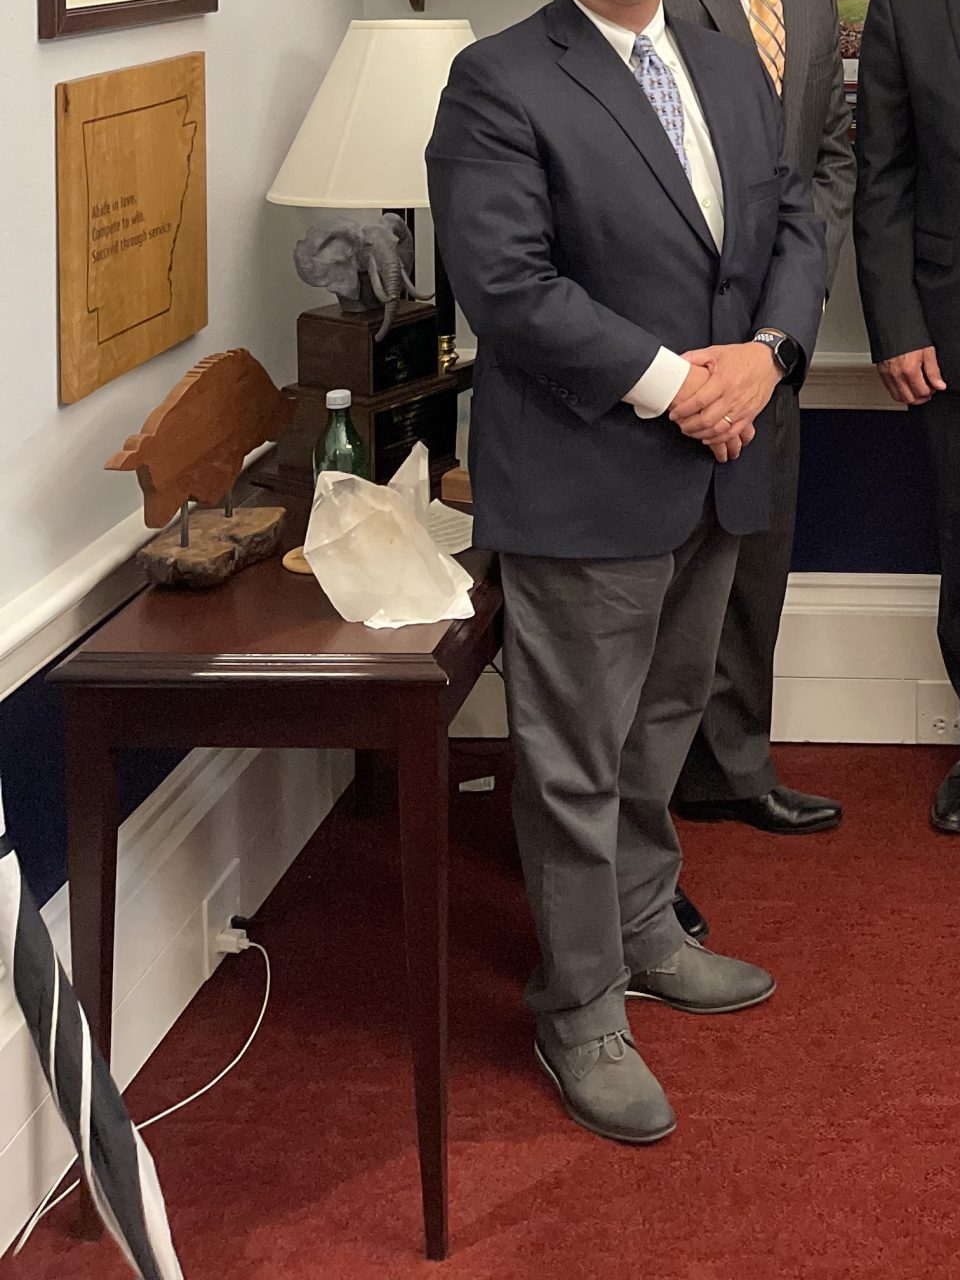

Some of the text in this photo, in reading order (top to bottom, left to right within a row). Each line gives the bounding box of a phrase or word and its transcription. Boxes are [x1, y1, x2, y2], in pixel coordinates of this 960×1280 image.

[92, 202, 110, 218] Abide
[112, 201, 119, 211] in
[92, 222, 120, 241] Compete
[122, 218, 130, 229] to
[92, 241, 118, 263] Succeed
[121, 229, 146, 250] through
